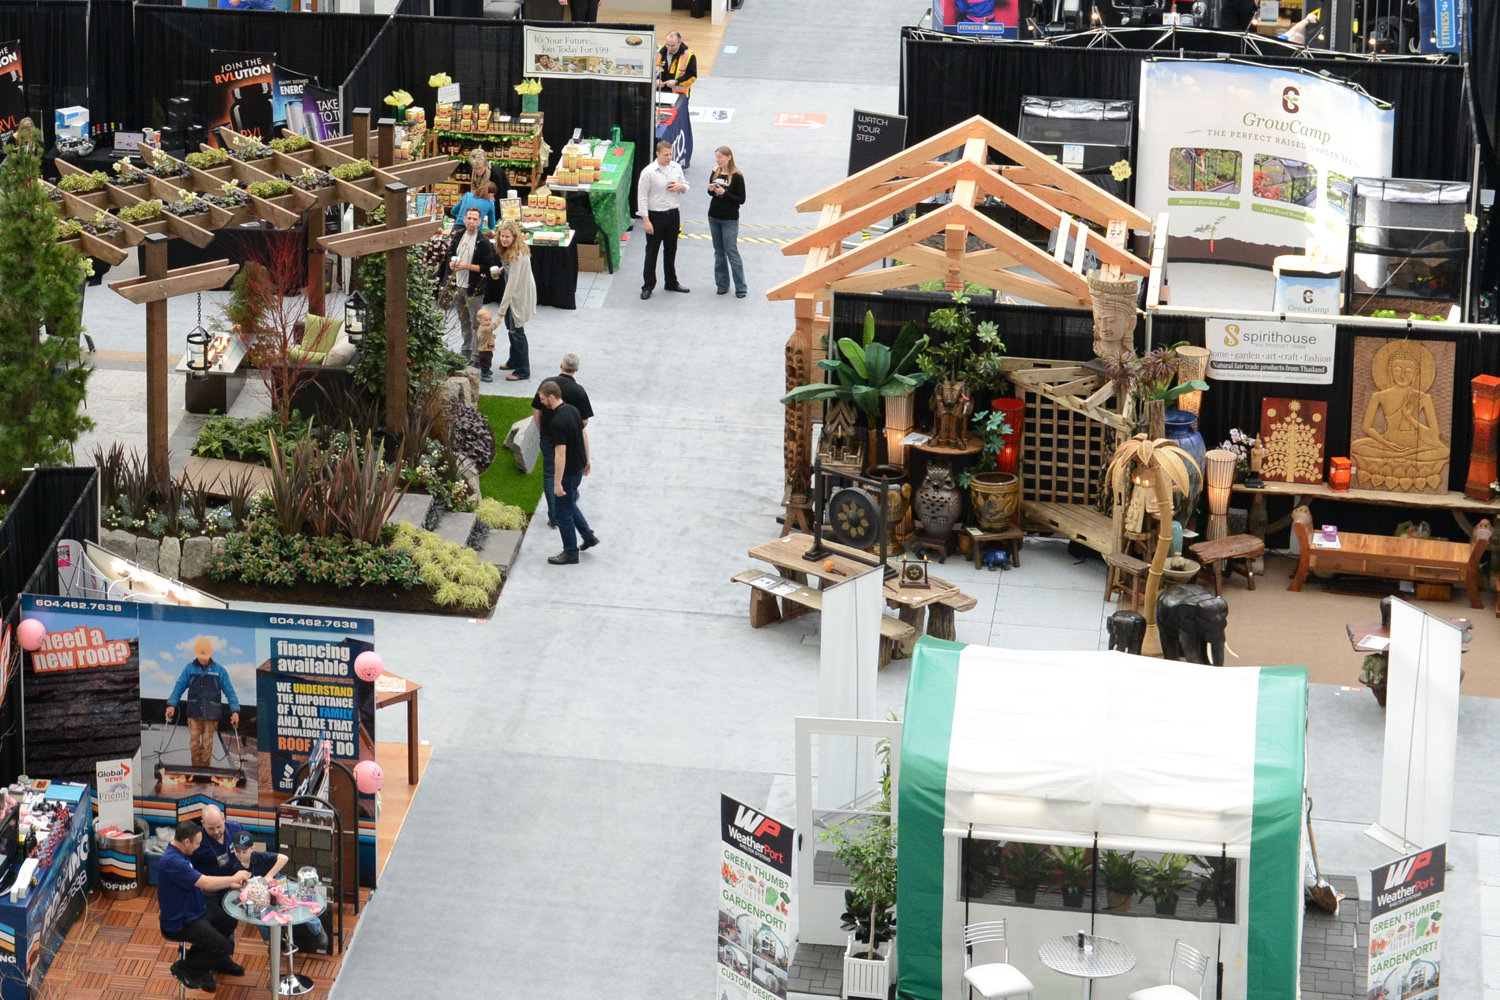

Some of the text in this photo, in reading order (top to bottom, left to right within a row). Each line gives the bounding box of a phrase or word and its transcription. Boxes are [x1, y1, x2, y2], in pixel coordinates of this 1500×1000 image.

[533, 34, 564, 45] It's Your
[541, 45, 555, 54] Join
[558, 46, 578, 55] Today
[220, 57, 262, 73] JOIN THE
[214, 64, 272, 84] RVLUTION
[316, 99, 339, 111] TAKE
[319, 110, 333, 122] TO
[857, 115, 889, 127] WATCH
[857, 124, 881, 135] YOUR
[1242, 111, 1331, 146] GrowCamp
[855, 133, 876, 142] STEP
[1207, 129, 1307, 150] THE PERFECT RAISED
[1243, 331, 1317, 345] spirithouse
[1234, 351, 1332, 363] garden art craft fashion
[1212, 361, 1326, 373] Natural fair trade products from Thailand
[35, 599, 122, 612] 604.462.7638
[269, 616, 358, 630] 604.462.7638
[89, 629, 103, 646] a
[33, 642, 128, 670] new roof?
[276, 640, 350, 662] financing
[277, 657, 349, 676] available
[276, 681, 354, 697] WE UNDERSTAND
[276, 692, 354, 709] THE IMPORTANCE
[276, 703, 354, 720] OF YOUR FAMILY
[276, 716, 354, 732] AND TAKE THAT
[277, 727, 354, 742] KNOWLEDGE EVERY
[277, 736, 355, 756] ROOF DO
[97, 769, 124, 779] Global
[99, 790, 130, 801] Friends
[727, 824, 784, 865] WeatherPort
[723, 849, 789, 891] GREEN THUMB?
[1376, 876, 1435, 908] WeatherPort
[722, 889, 788, 933] GARDENPORT!
[1372, 899, 1441, 934] GREEN THUMB?
[1370, 940, 1438, 976] GARDENPORT!
[721, 967, 751, 991] CUSTOM
